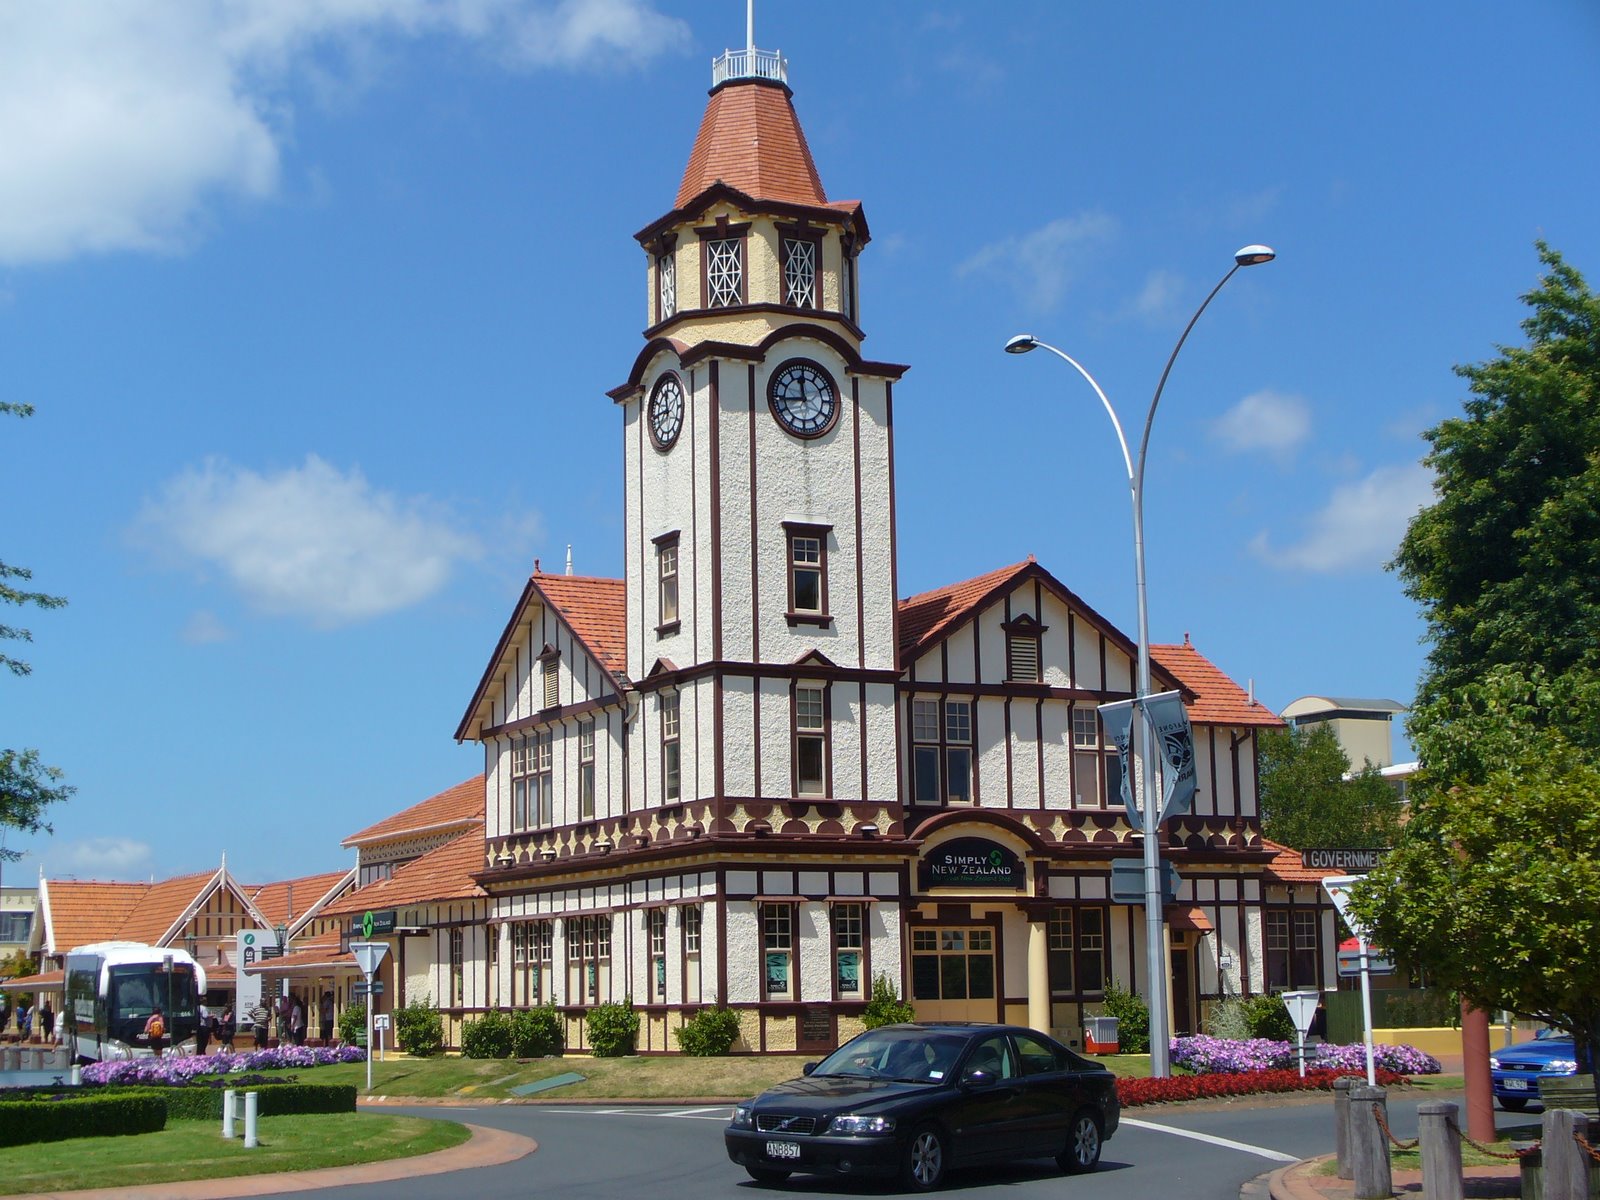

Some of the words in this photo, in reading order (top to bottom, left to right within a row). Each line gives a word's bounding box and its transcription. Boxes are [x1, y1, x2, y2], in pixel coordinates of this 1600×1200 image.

[945, 855, 987, 864] SIMPLY
[932, 865, 957, 874] NEW
[961, 865, 1011, 875] ZEALAND
[767, 1143, 799, 1156] ANB857
